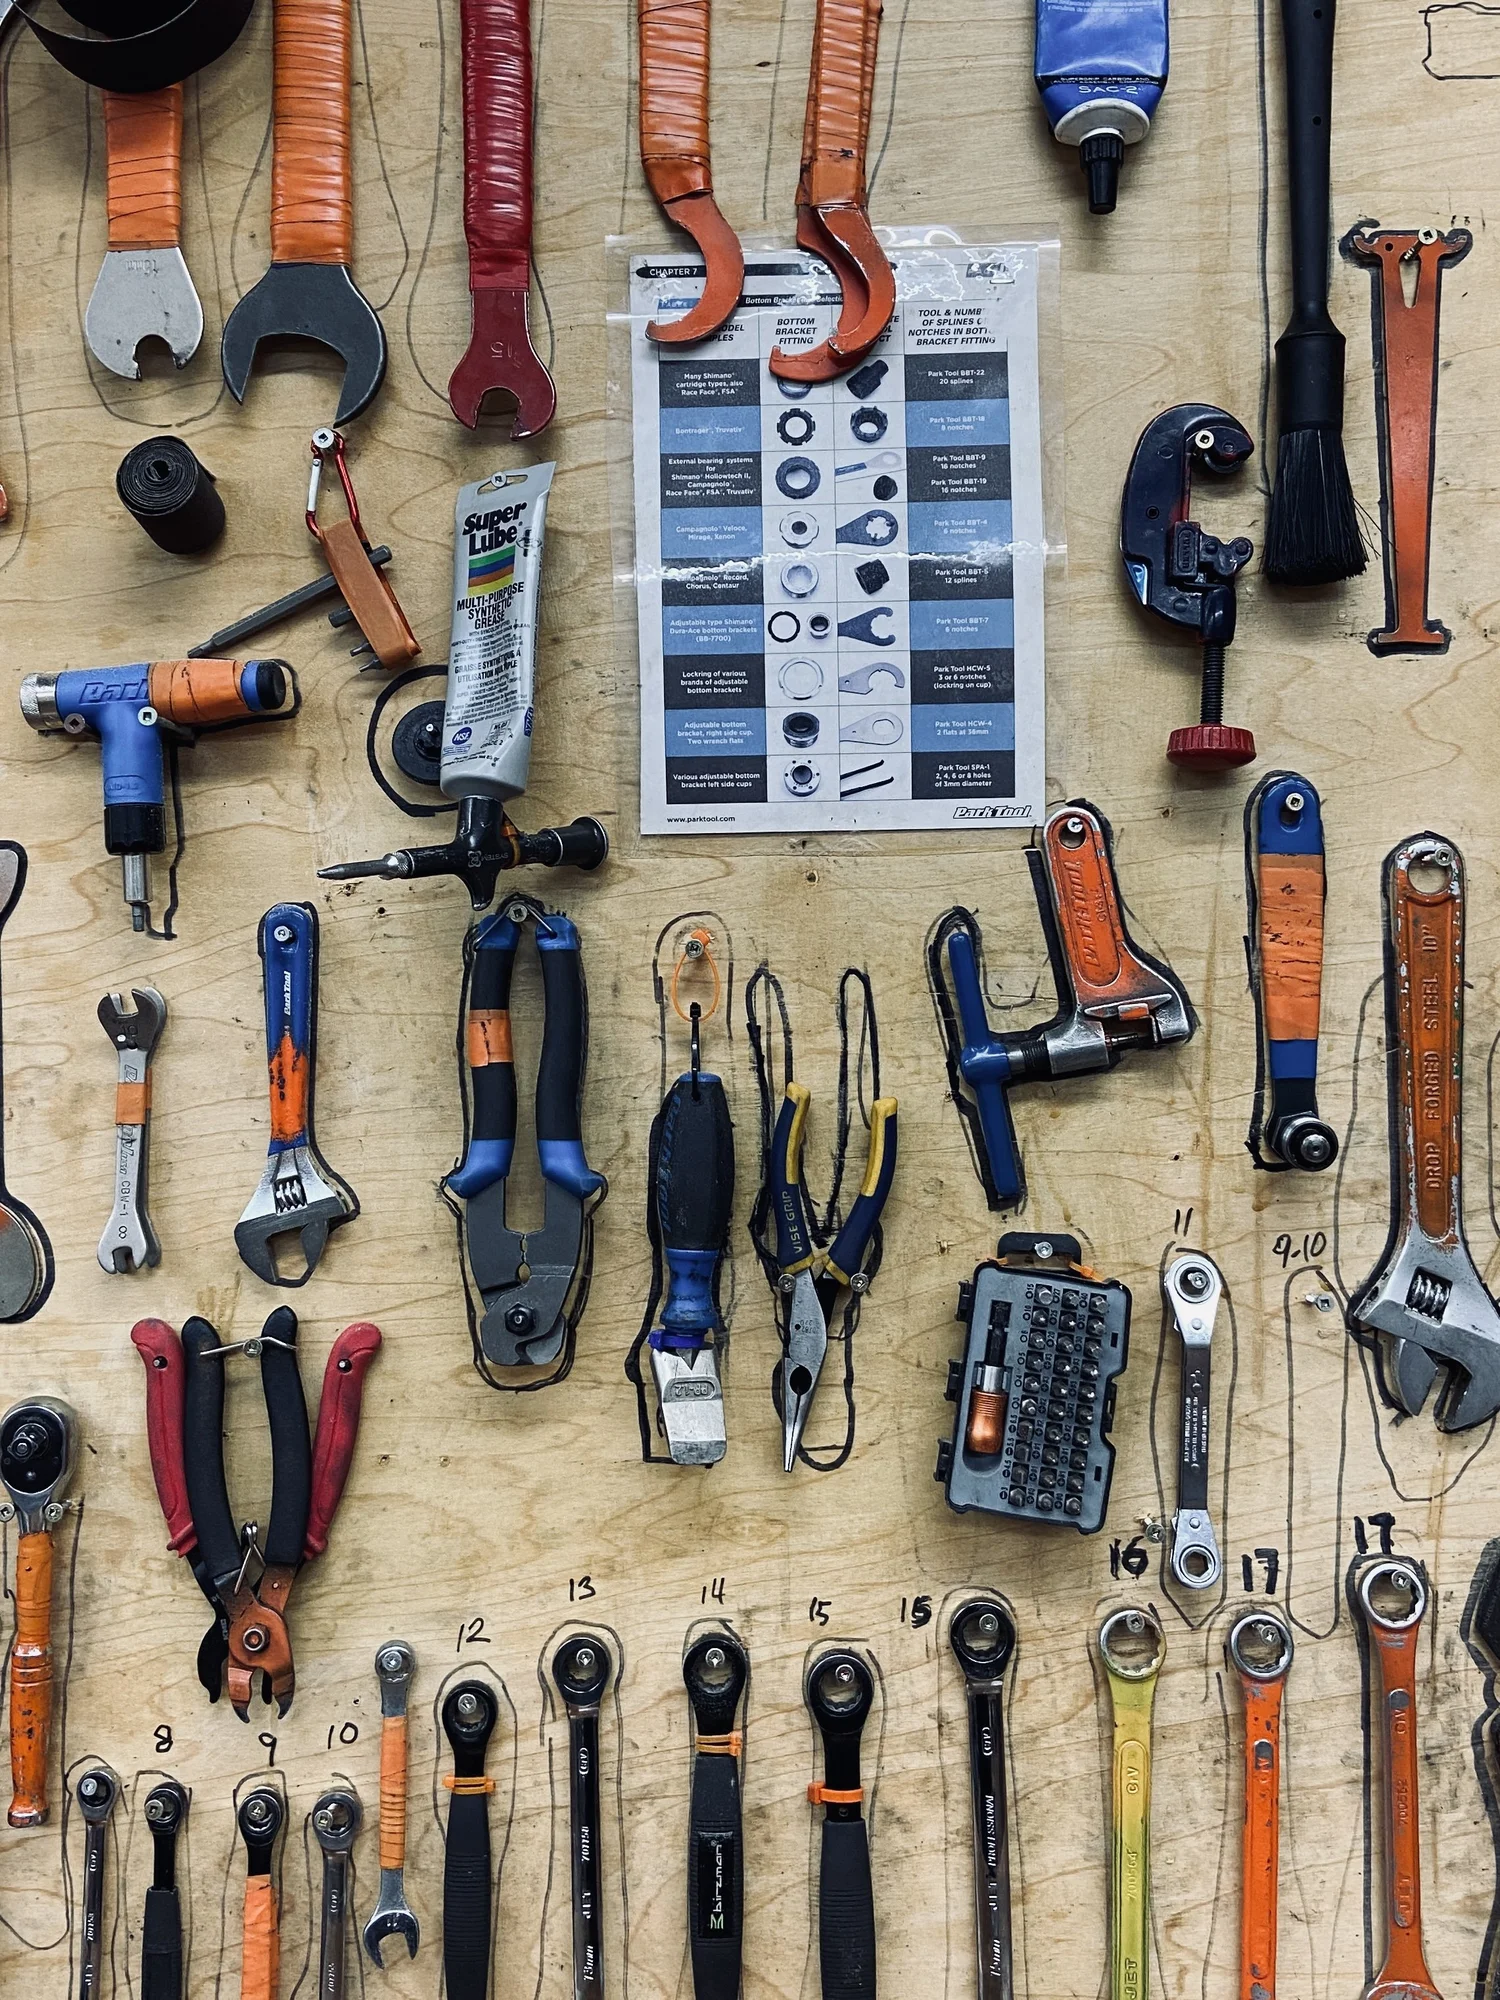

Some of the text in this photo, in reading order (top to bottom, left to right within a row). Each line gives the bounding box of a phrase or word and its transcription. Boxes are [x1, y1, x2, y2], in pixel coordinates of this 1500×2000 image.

[1079, 86, 1138, 94] SAC-2
[650, 268, 697, 276] CHAPTER 7
[918, 309, 942, 317] TOOL
[937, 318, 974, 326] SPLINES
[775, 327, 817, 335] BRACKET
[779, 337, 814, 345] FITTING
[908, 327, 963, 336] NOTCHES IN
[916, 337, 996, 346] BRACKET FITTING
[462, 502, 527, 535] Super
[469, 524, 518, 556] Lube
[457, 582, 524, 611] MULTI-PURPOSE
[468, 596, 512, 619] SYNTHETIC
[475, 610, 505, 630] GREASE
[670, 619, 706, 627] Adjustable
[1423, 972, 1439, 1031] STEEL
[1424, 1051, 1441, 1121] FORGED
[1425, 1142, 1441, 1190] DROP
[120, 1180, 131, 1218] CBW-1
[118, 1225, 128, 1239] 8
[782, 1191, 803, 1254] VISE GRIP
[1109, 1535, 1149, 1580] 16
[1242, 1547, 1279, 1595] 17
[568, 1575, 597, 1602] 13
[701, 1577, 726, 1605] 14
[808, 1596, 832, 1626] 15
[456, 1617, 491, 1653] 12
[153, 1724, 173, 1753] 8
[258, 1731, 278, 1766] 9
[327, 1722, 359, 1750] 10
[712, 1844, 723, 1913] birzman
[1125, 1957, 1139, 2000] JET
